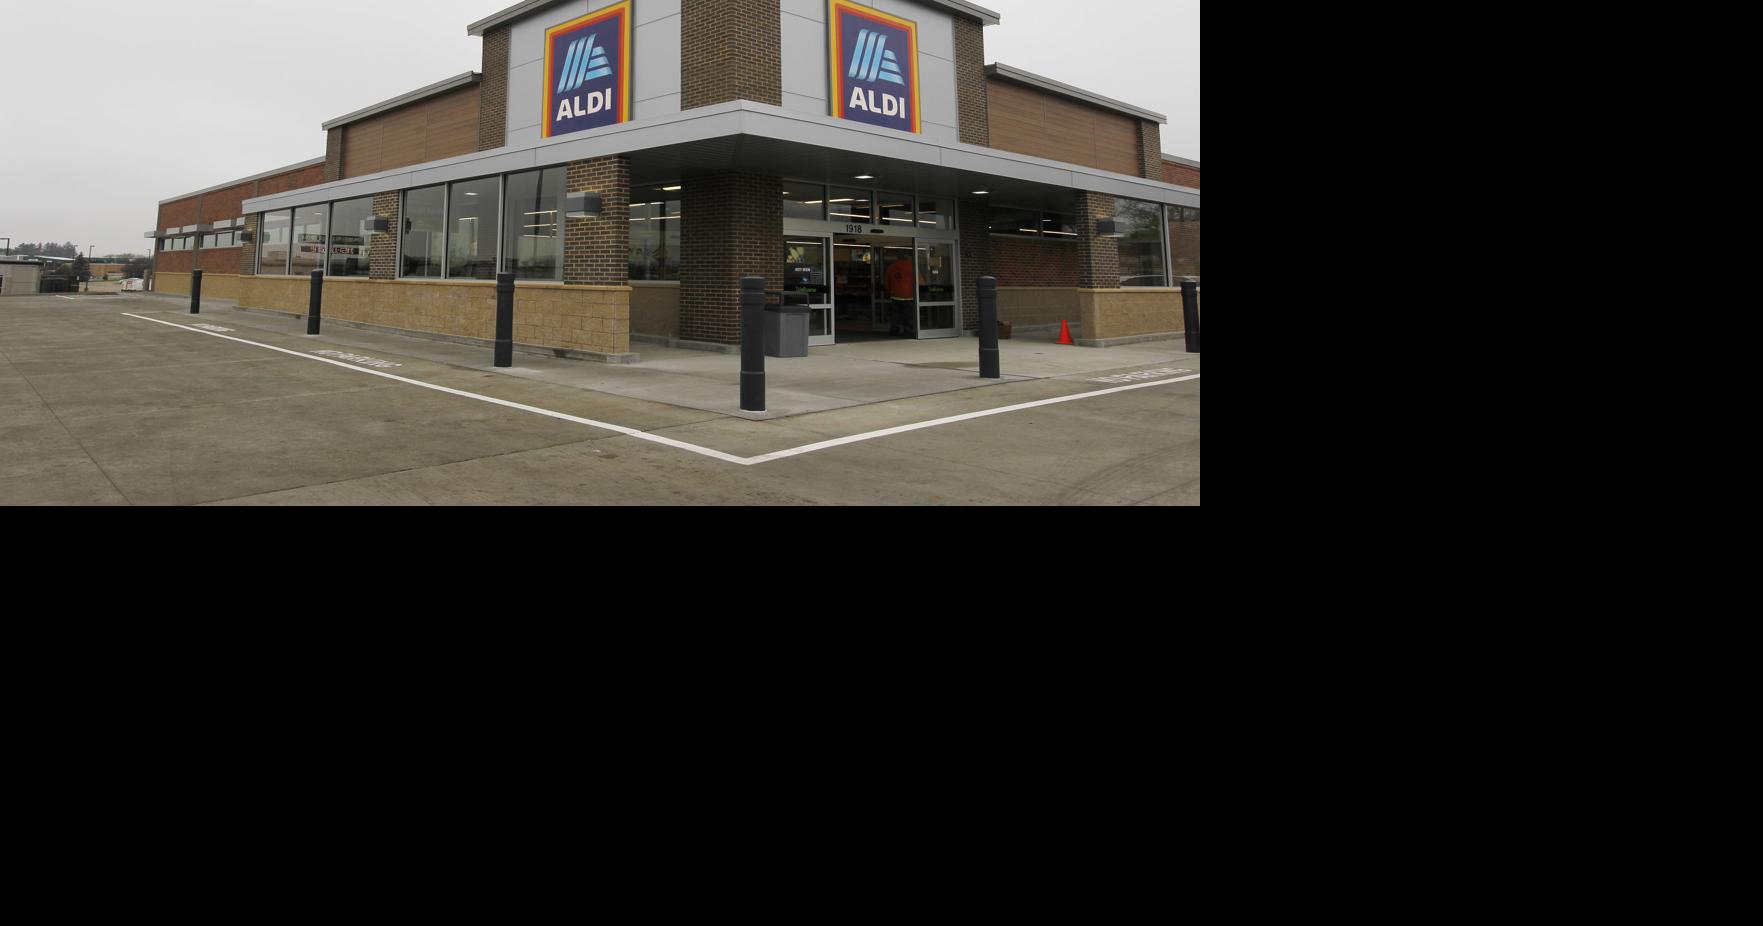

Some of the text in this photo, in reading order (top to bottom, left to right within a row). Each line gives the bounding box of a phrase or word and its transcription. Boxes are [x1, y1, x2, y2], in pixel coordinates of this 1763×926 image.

[556, 87, 612, 122] ALDI
[849, 86, 906, 119] ALDI
[846, 224, 862, 233] 1918
